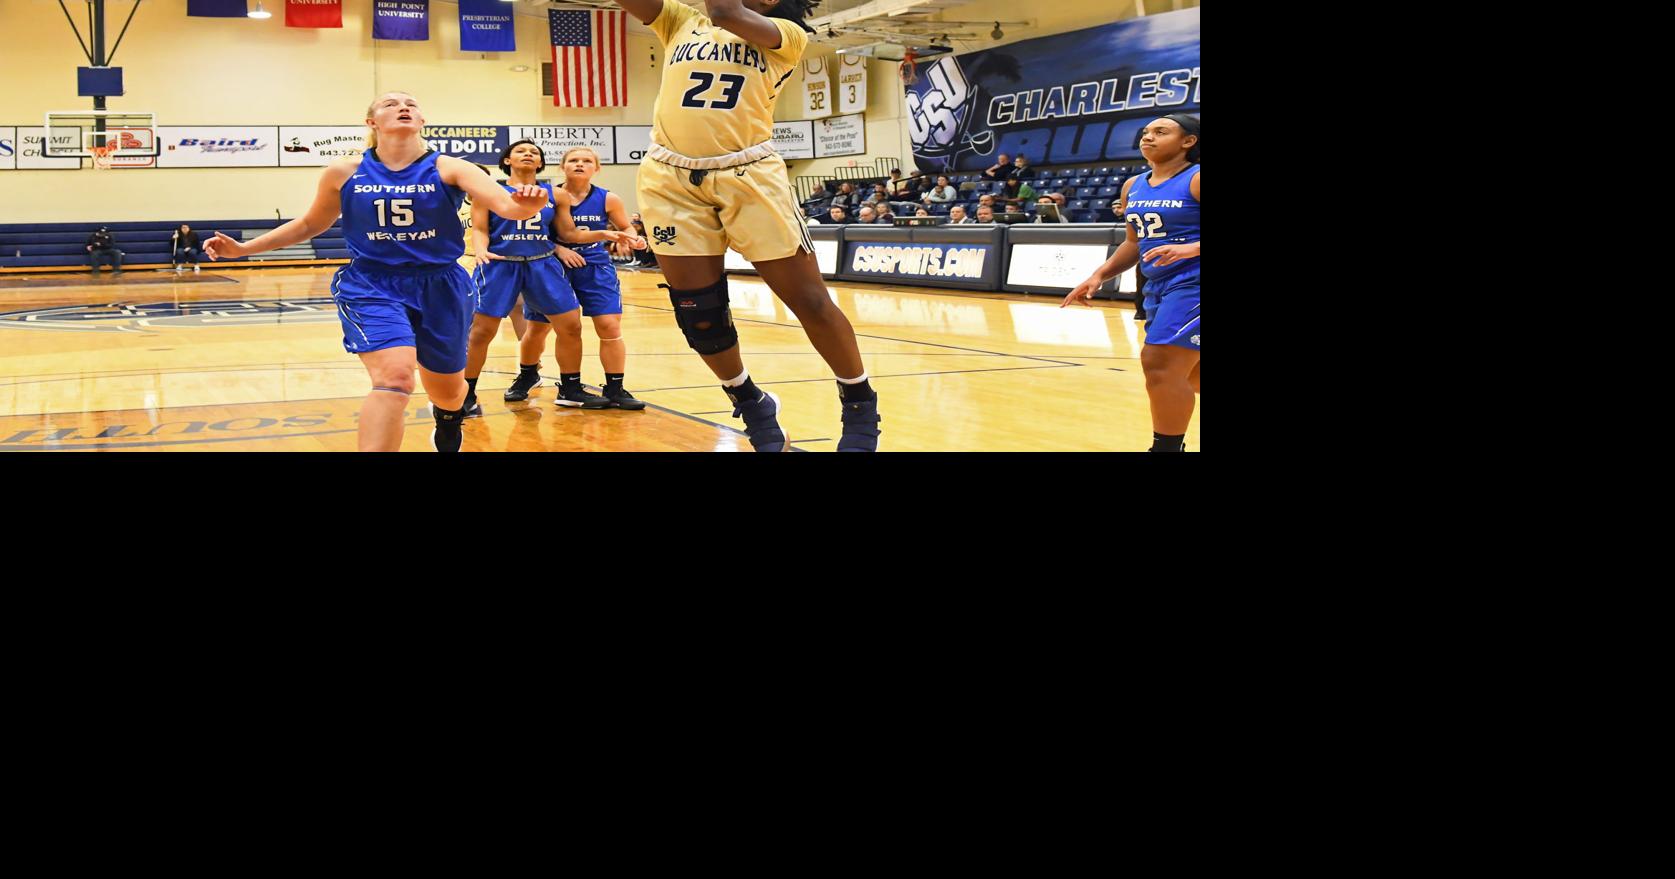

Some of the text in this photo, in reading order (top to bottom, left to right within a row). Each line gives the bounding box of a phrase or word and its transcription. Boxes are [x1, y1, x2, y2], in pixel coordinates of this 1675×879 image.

[378, 1, 425, 10] HIGH POINT
[378, 10, 425, 19] UNIVERSITY
[462, 14, 510, 22] PRESBYTERIAN
[471, 22, 501, 31] COLLEGE
[669, 41, 767, 74] BUCCANEERS
[681, 71, 746, 110] 23
[848, 84, 856, 104] 3
[986, 67, 1201, 127] CHARLES
[809, 91, 825, 111] 32
[420, 127, 497, 138] UCCANEERS
[520, 127, 604, 140] LIBERTY
[23, 135, 73, 144] SUMIT
[313, 139, 332, 148] Rug
[450, 139, 477, 153] DO
[478, 139, 501, 153] IT.
[354, 184, 436, 193] SOUTHERN
[373, 198, 415, 227] 15
[1126, 212, 1167, 238] 32
[366, 229, 436, 241] WESLEYAN
[653, 225, 676, 239] CSU
[852, 246, 987, 278] CSUSPORTS.COM
